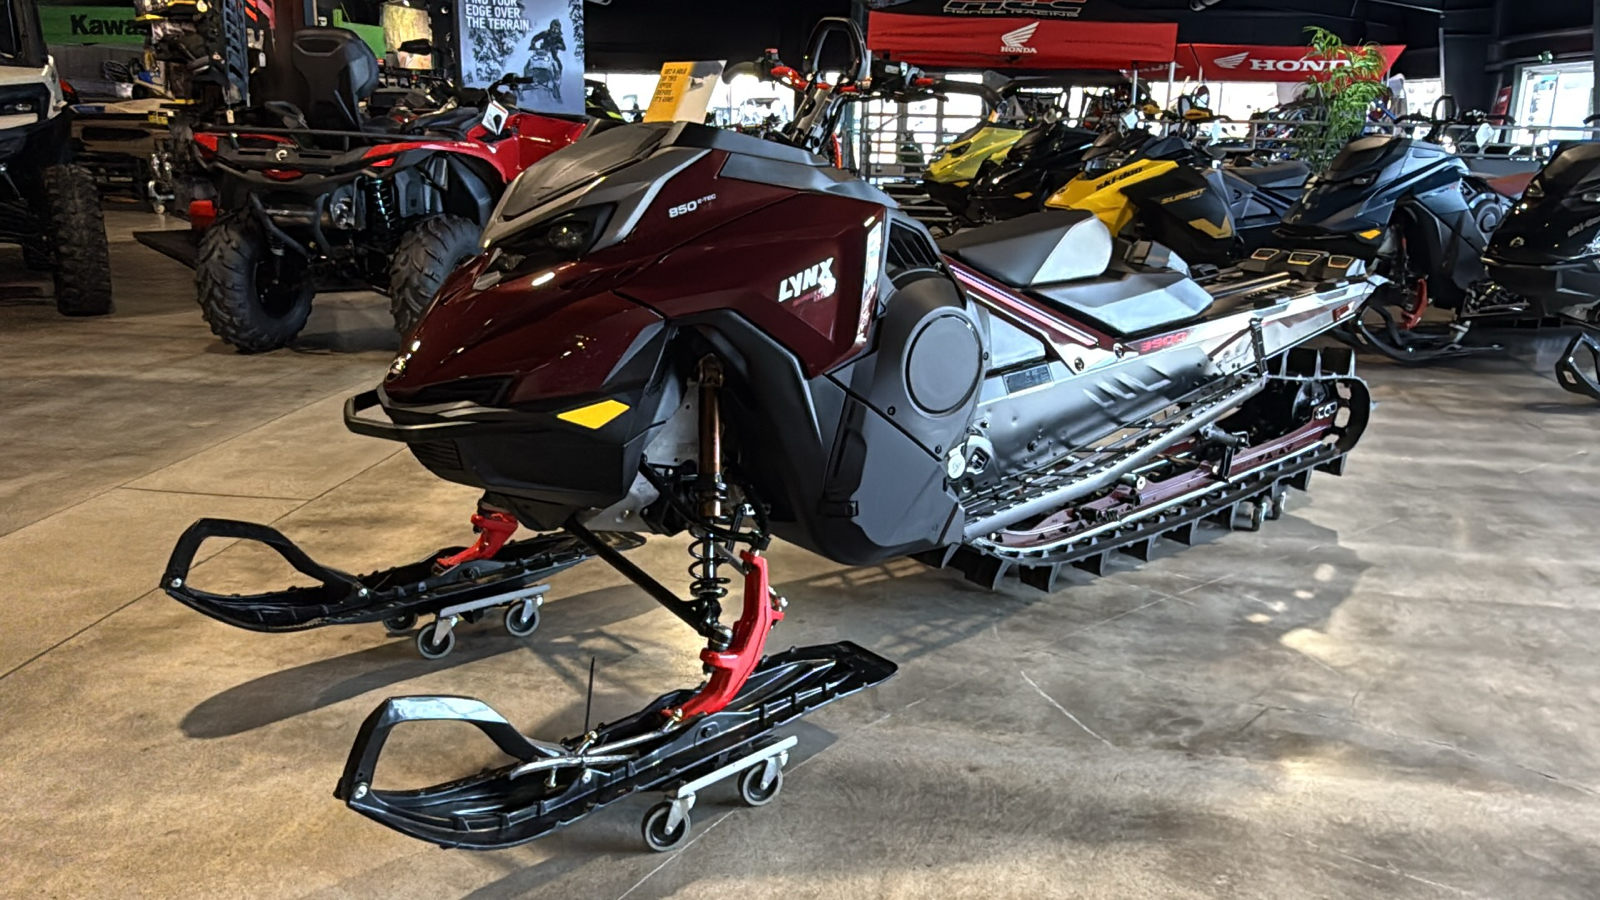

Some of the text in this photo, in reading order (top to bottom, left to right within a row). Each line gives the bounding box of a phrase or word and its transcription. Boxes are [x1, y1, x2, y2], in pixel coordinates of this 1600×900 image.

[465, 4, 521, 19] EDGE OVER
[465, 15, 533, 32] THE TERRAIN.
[1000, 46, 1038, 54] HONDA
[1249, 58, 1354, 72] HOND
[668, 200, 698, 219] 850
[778, 257, 834, 303] LYNX
